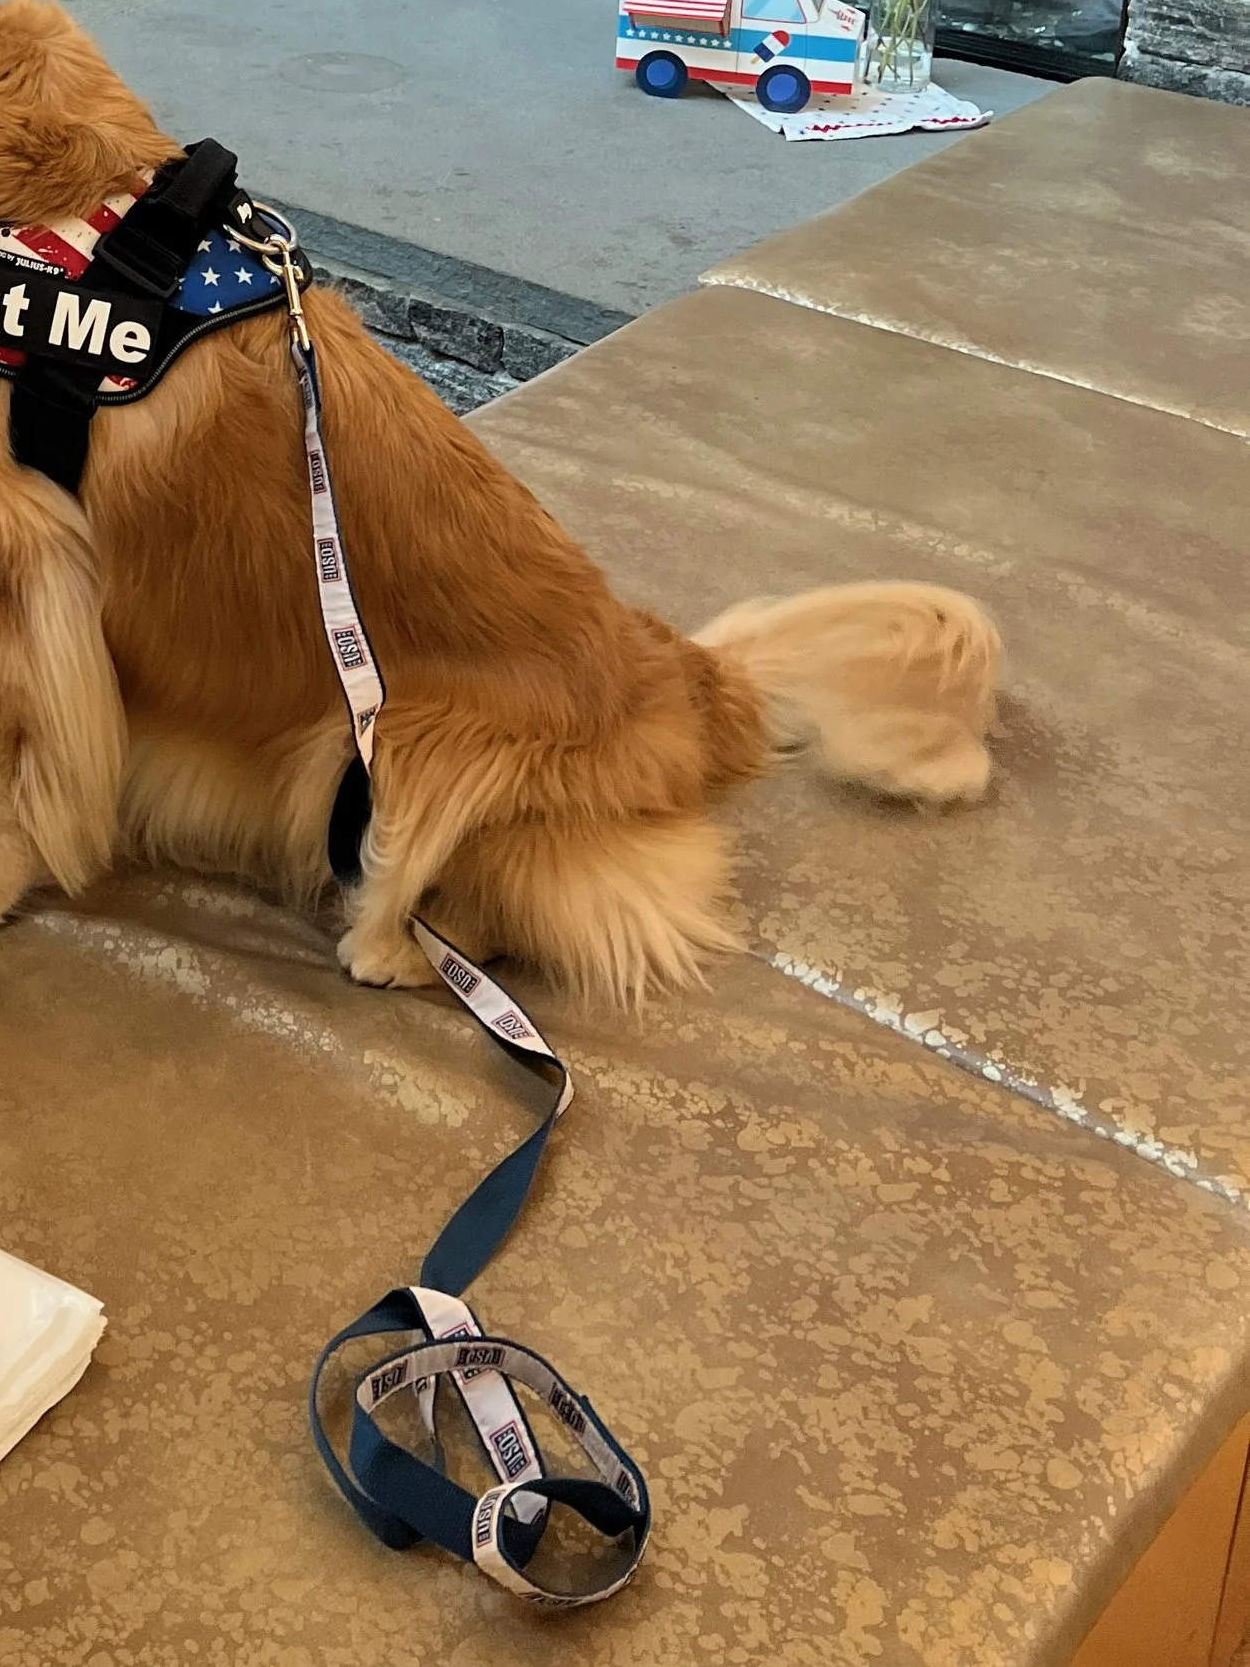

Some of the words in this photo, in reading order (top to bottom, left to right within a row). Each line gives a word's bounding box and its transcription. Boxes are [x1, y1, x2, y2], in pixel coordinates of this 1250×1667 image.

[48, 291, 151, 364] Me
[321, 547, 338, 575] USO
[337, 635, 362, 666] USO
[447, 962, 473, 990] USO
[500, 1432, 525, 1472] USO
[477, 1496, 496, 1533] USO
